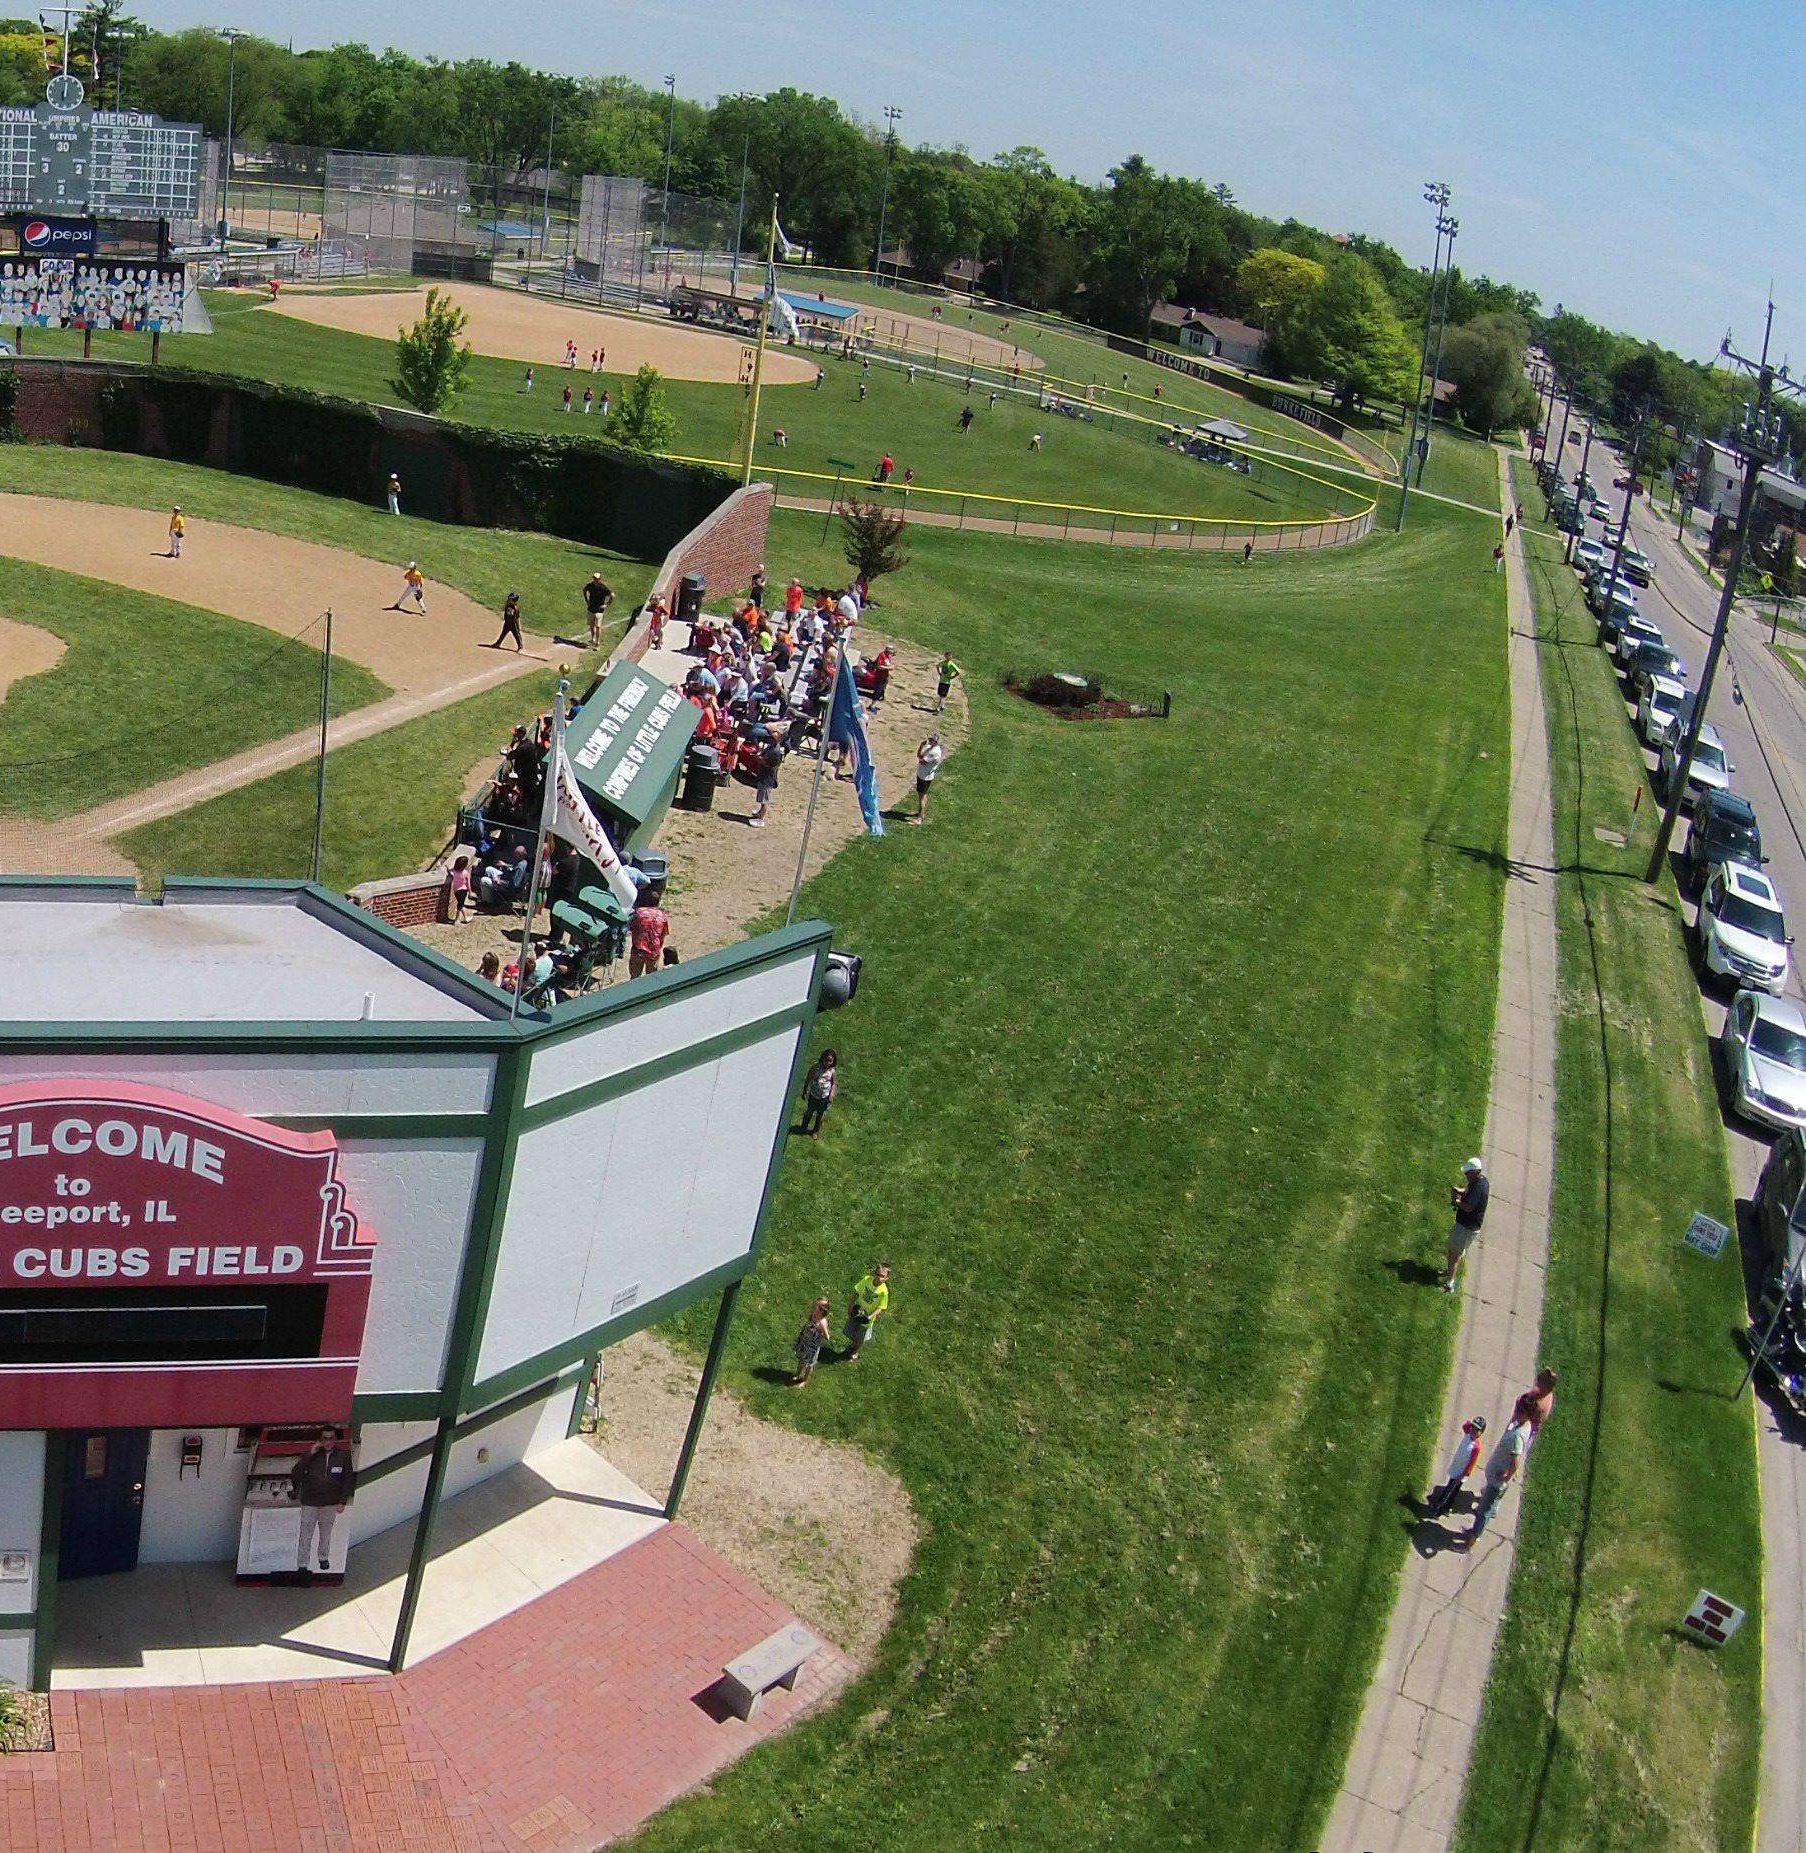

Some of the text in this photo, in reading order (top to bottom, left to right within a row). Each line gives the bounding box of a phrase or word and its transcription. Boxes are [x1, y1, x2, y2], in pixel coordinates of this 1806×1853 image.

[91, 112, 153, 127] AMERICAN
[55, 141, 70, 152] 30
[42, 162, 49, 174] 3
[75, 163, 83, 175] 2
[58, 184, 65, 196] 2
[52, 230, 92, 242] pepsi
[1146, 347, 1211, 380] WELCOME TO
[607, 703, 631, 724] THE
[599, 718, 621, 735] TO
[633, 723, 661, 754] LITTLE
[574, 728, 614, 770] WELCOME
[55, 1173, 91, 1198] to
[144, 1200, 177, 1223] IL
[13, 1246, 151, 1278] CUBS
[167, 1245, 304, 1275] FIELD
